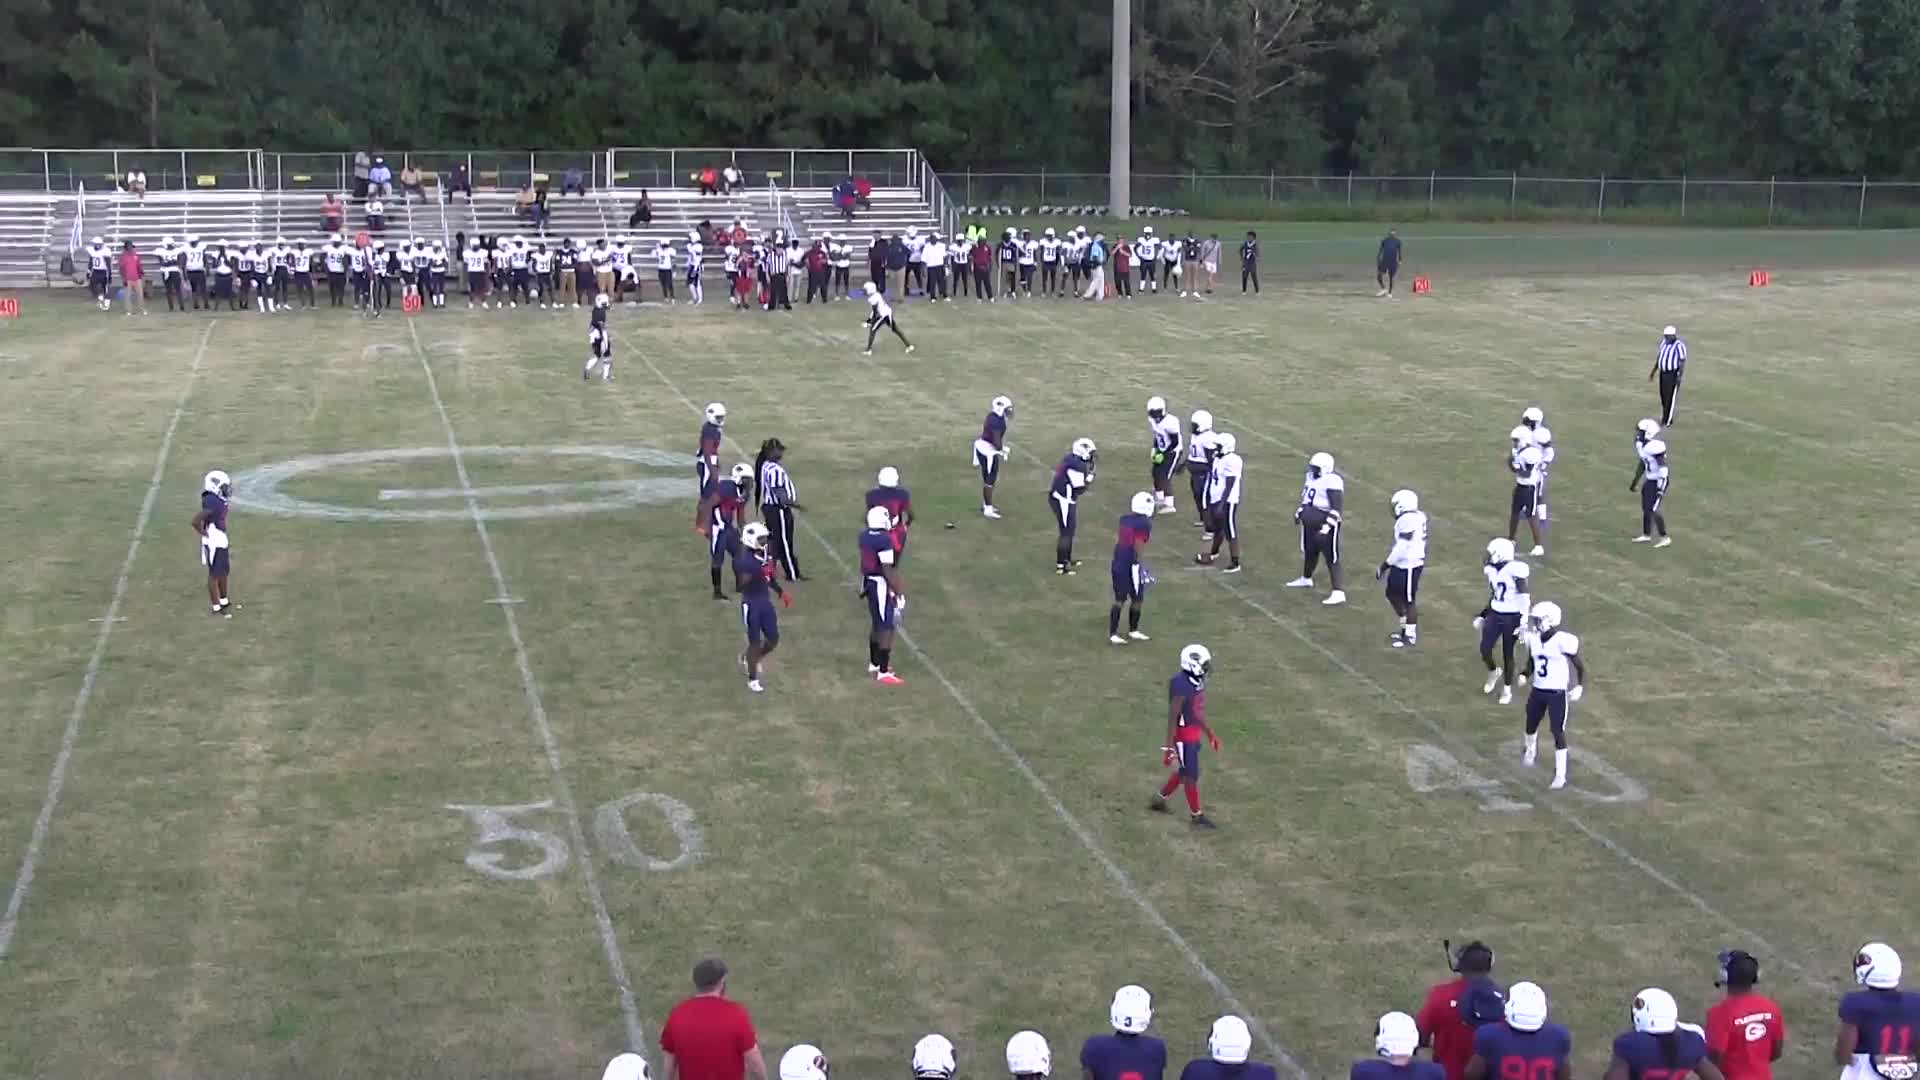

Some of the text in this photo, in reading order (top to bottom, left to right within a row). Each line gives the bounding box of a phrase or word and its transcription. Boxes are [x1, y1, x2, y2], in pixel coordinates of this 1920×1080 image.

[1003, 249, 1012, 260] 10
[404, 295, 420, 309] 50
[1536, 654, 1548, 678] 3
[445, 792, 705, 880] 50
[1124, 1016, 1132, 1028] 3
[1745, 1022, 1767, 1042] G
[1880, 1023, 1912, 1056] 11
